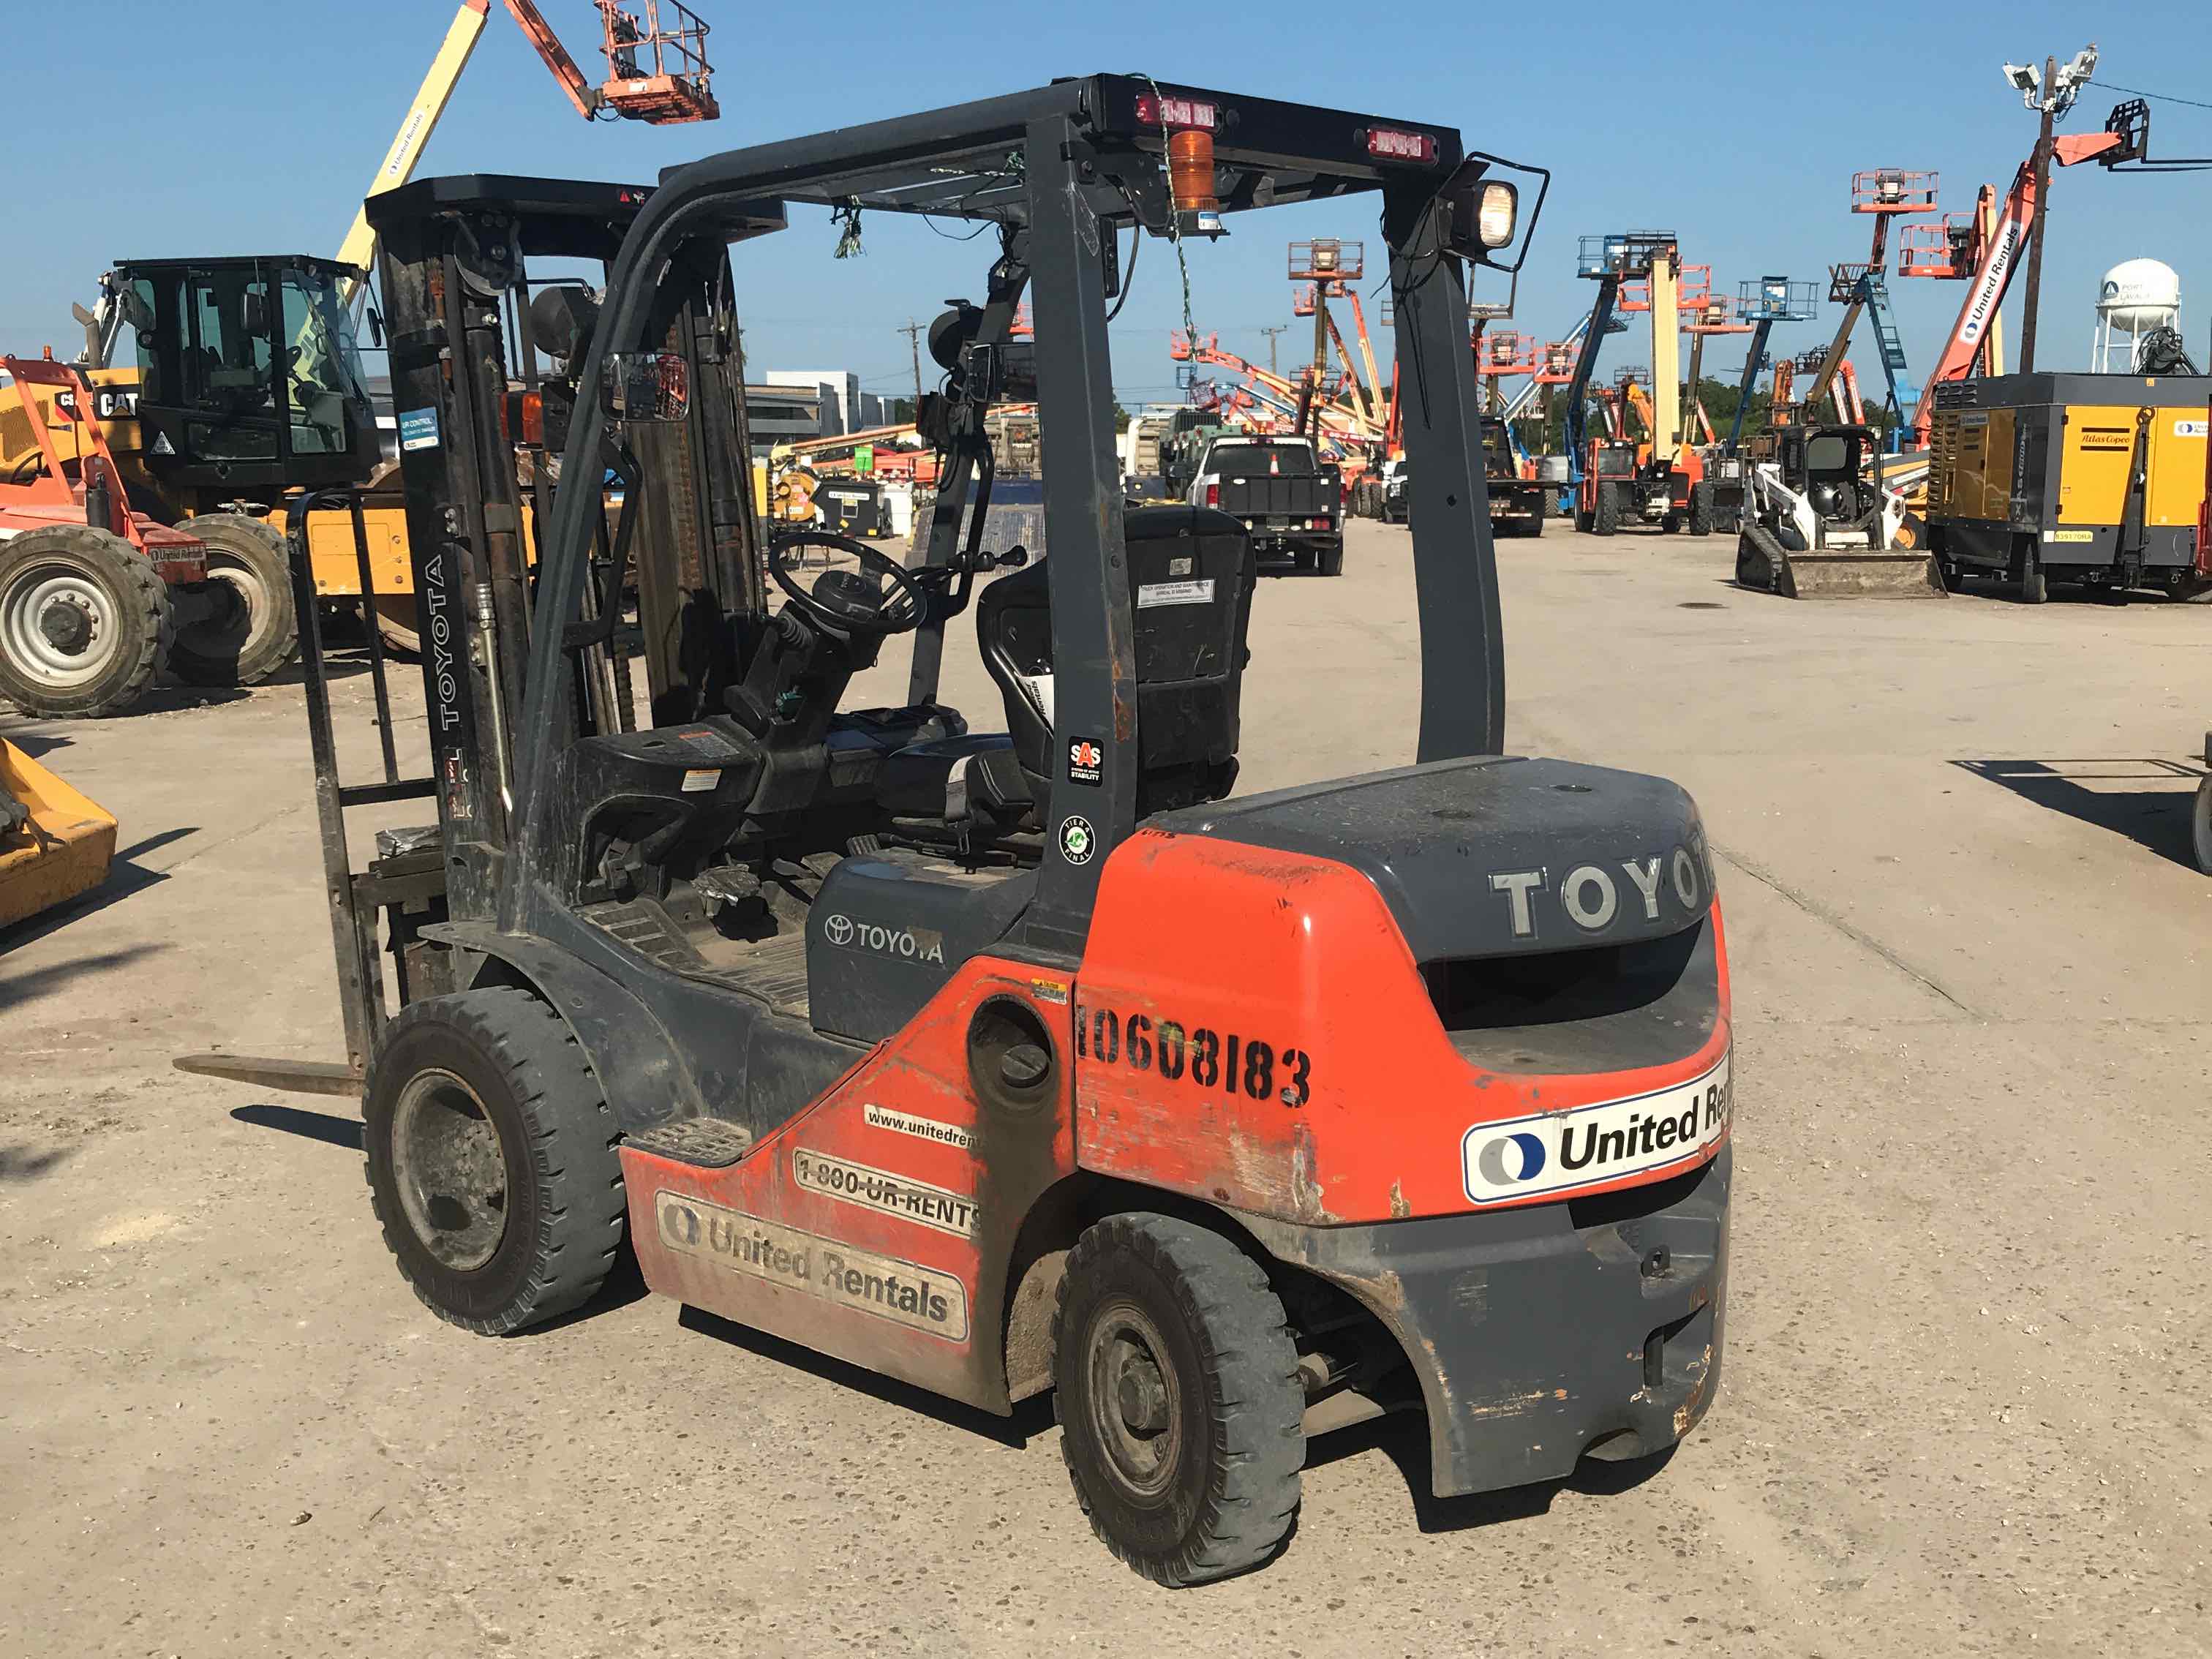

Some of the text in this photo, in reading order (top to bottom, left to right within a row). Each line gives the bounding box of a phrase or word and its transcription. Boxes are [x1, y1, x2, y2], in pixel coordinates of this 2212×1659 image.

[1972, 227, 2018, 320] United Rentals
[100, 393, 138, 416] CAT
[2082, 435, 2130, 445] Atlas Copco
[425, 554, 459, 731] TOYOTA
[1071, 742, 1101, 768] SAS
[1071, 772, 1099, 780] STABILITY
[1064, 819, 1084, 830] TIER
[1064, 849, 1090, 862] FINAL
[1077, 1004, 1312, 1108] 10608183
[1560, 1095, 1699, 1170] United
[708, 1217, 949, 1323] United Rentals
